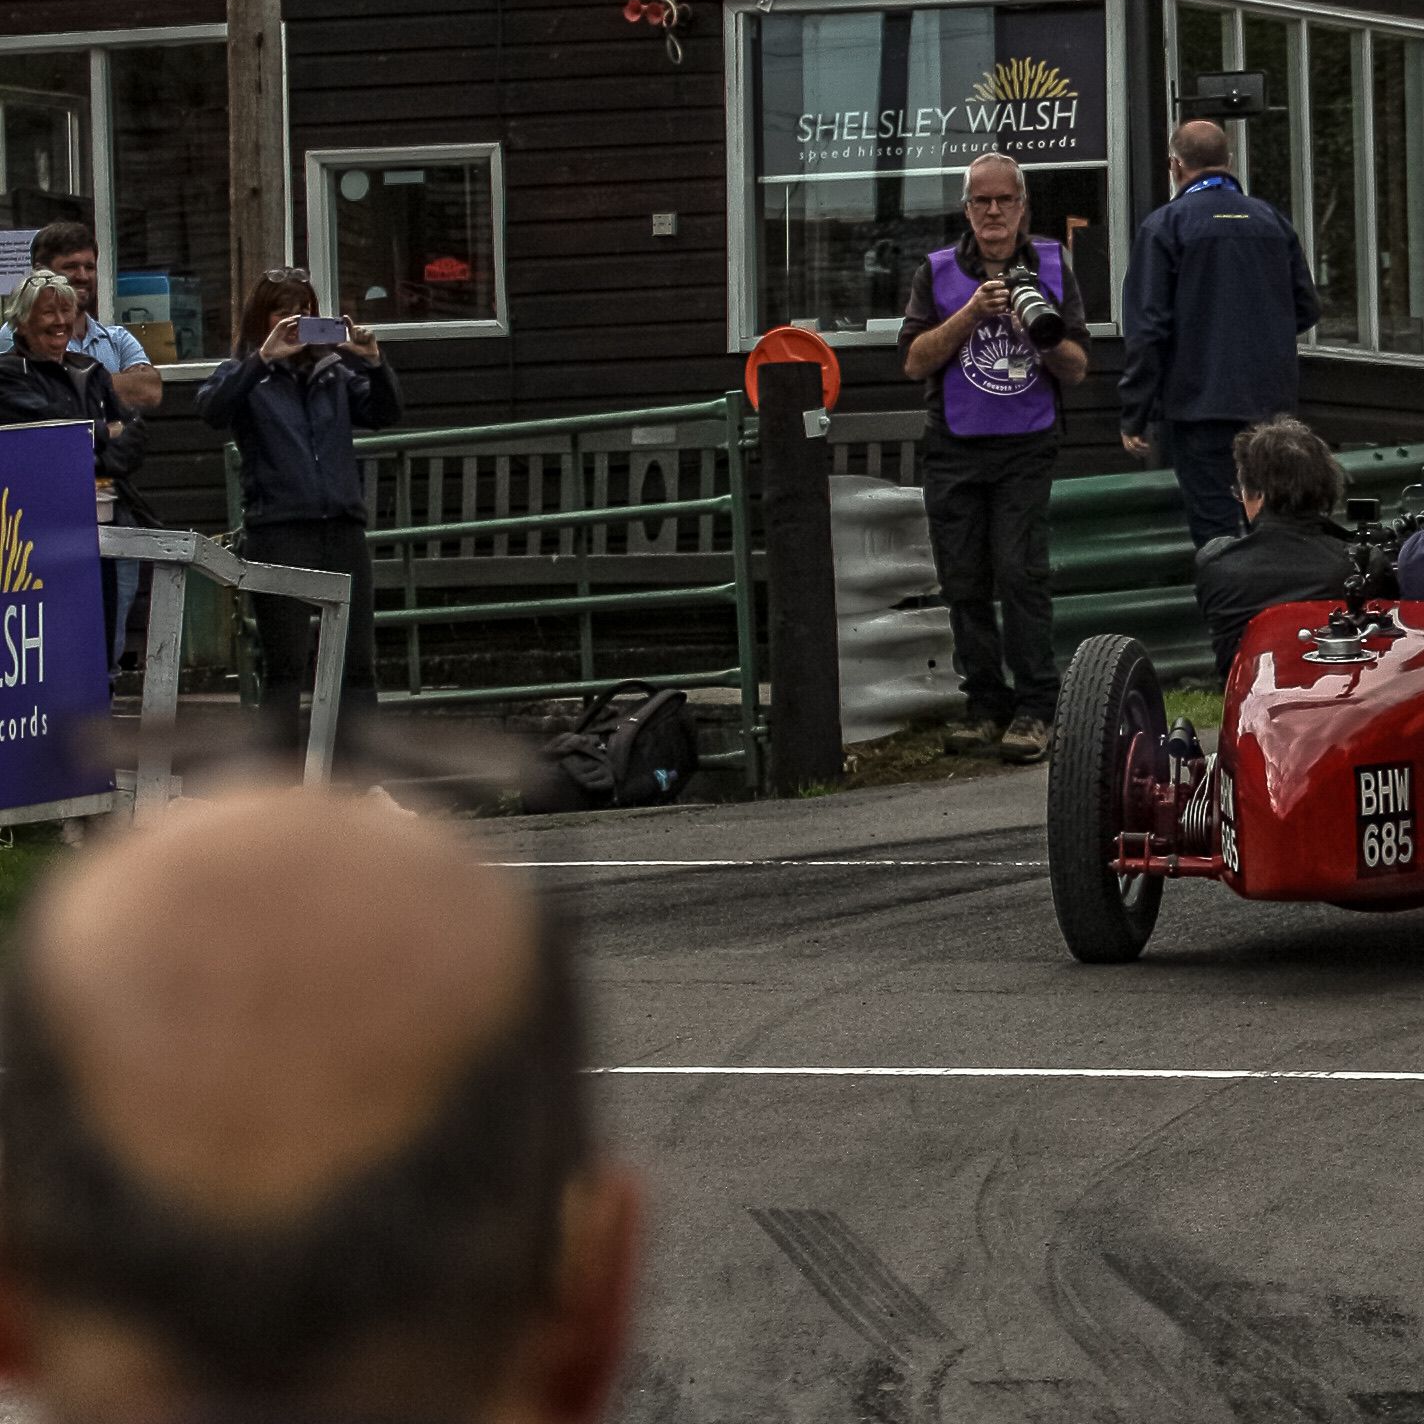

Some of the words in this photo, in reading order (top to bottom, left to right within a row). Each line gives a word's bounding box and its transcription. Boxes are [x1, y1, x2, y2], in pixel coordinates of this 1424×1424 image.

[797, 106, 957, 143] SHELSLEY
[965, 99, 1078, 134] WALSH
[799, 146, 850, 163] speed
[857, 144, 923, 159] history
[941, 140, 998, 156] future
[1006, 135, 1077, 151] records
[0, 601, 44, 688] SH
[1360, 766, 1411, 817] BHW
[1363, 820, 1414, 868] 685
